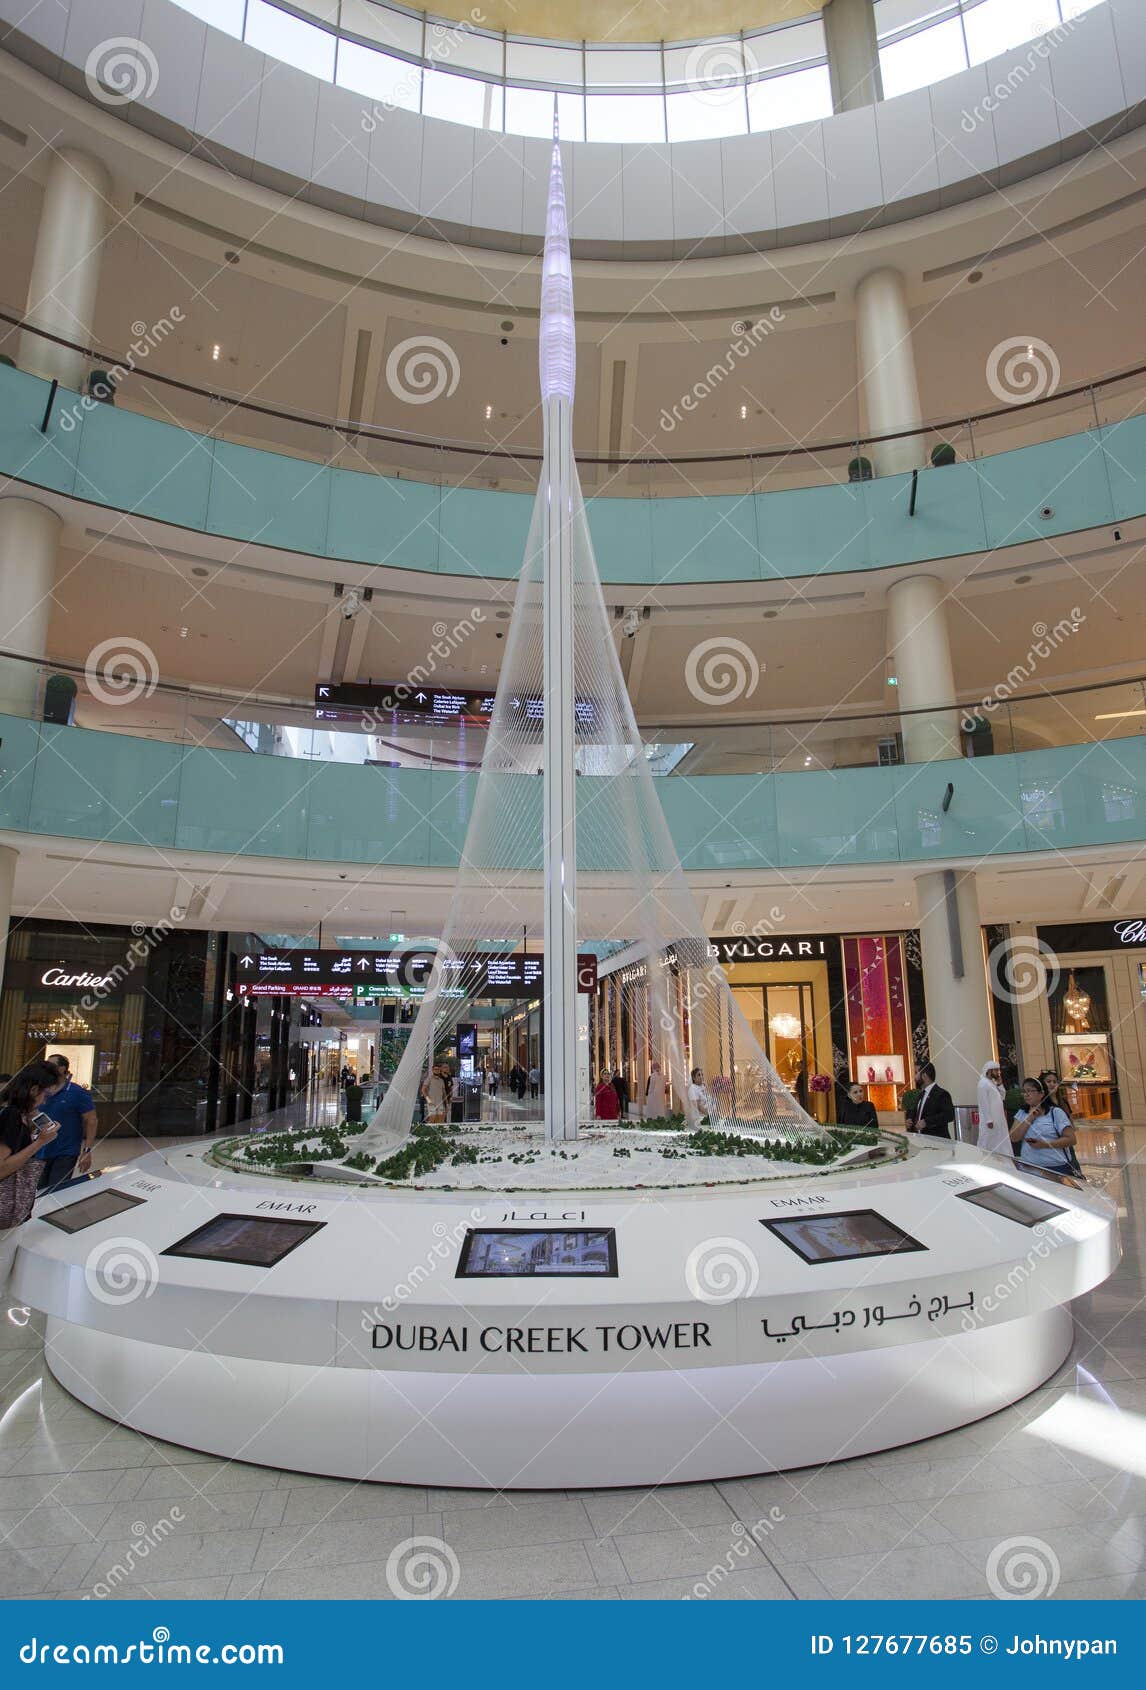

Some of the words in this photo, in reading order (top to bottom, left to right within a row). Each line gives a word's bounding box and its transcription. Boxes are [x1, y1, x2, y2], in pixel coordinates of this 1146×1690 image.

[707, 941, 825, 957] BVLGARI
[41, 968, 113, 987] Cartier
[578, 968, 594, 987] G
[240, 985, 247, 994] P
[357, 986, 364, 995] P
[255, 1200, 317, 1214] EMAAR
[770, 1195, 829, 1208] EMAAR
[927, 1288, 975, 1321] برج
[761, 1310, 855, 1343] دبي
[371, 1324, 467, 1352] DUBAI
[479, 1326, 589, 1352] CREEK
[595, 1322, 712, 1352] TOWER
